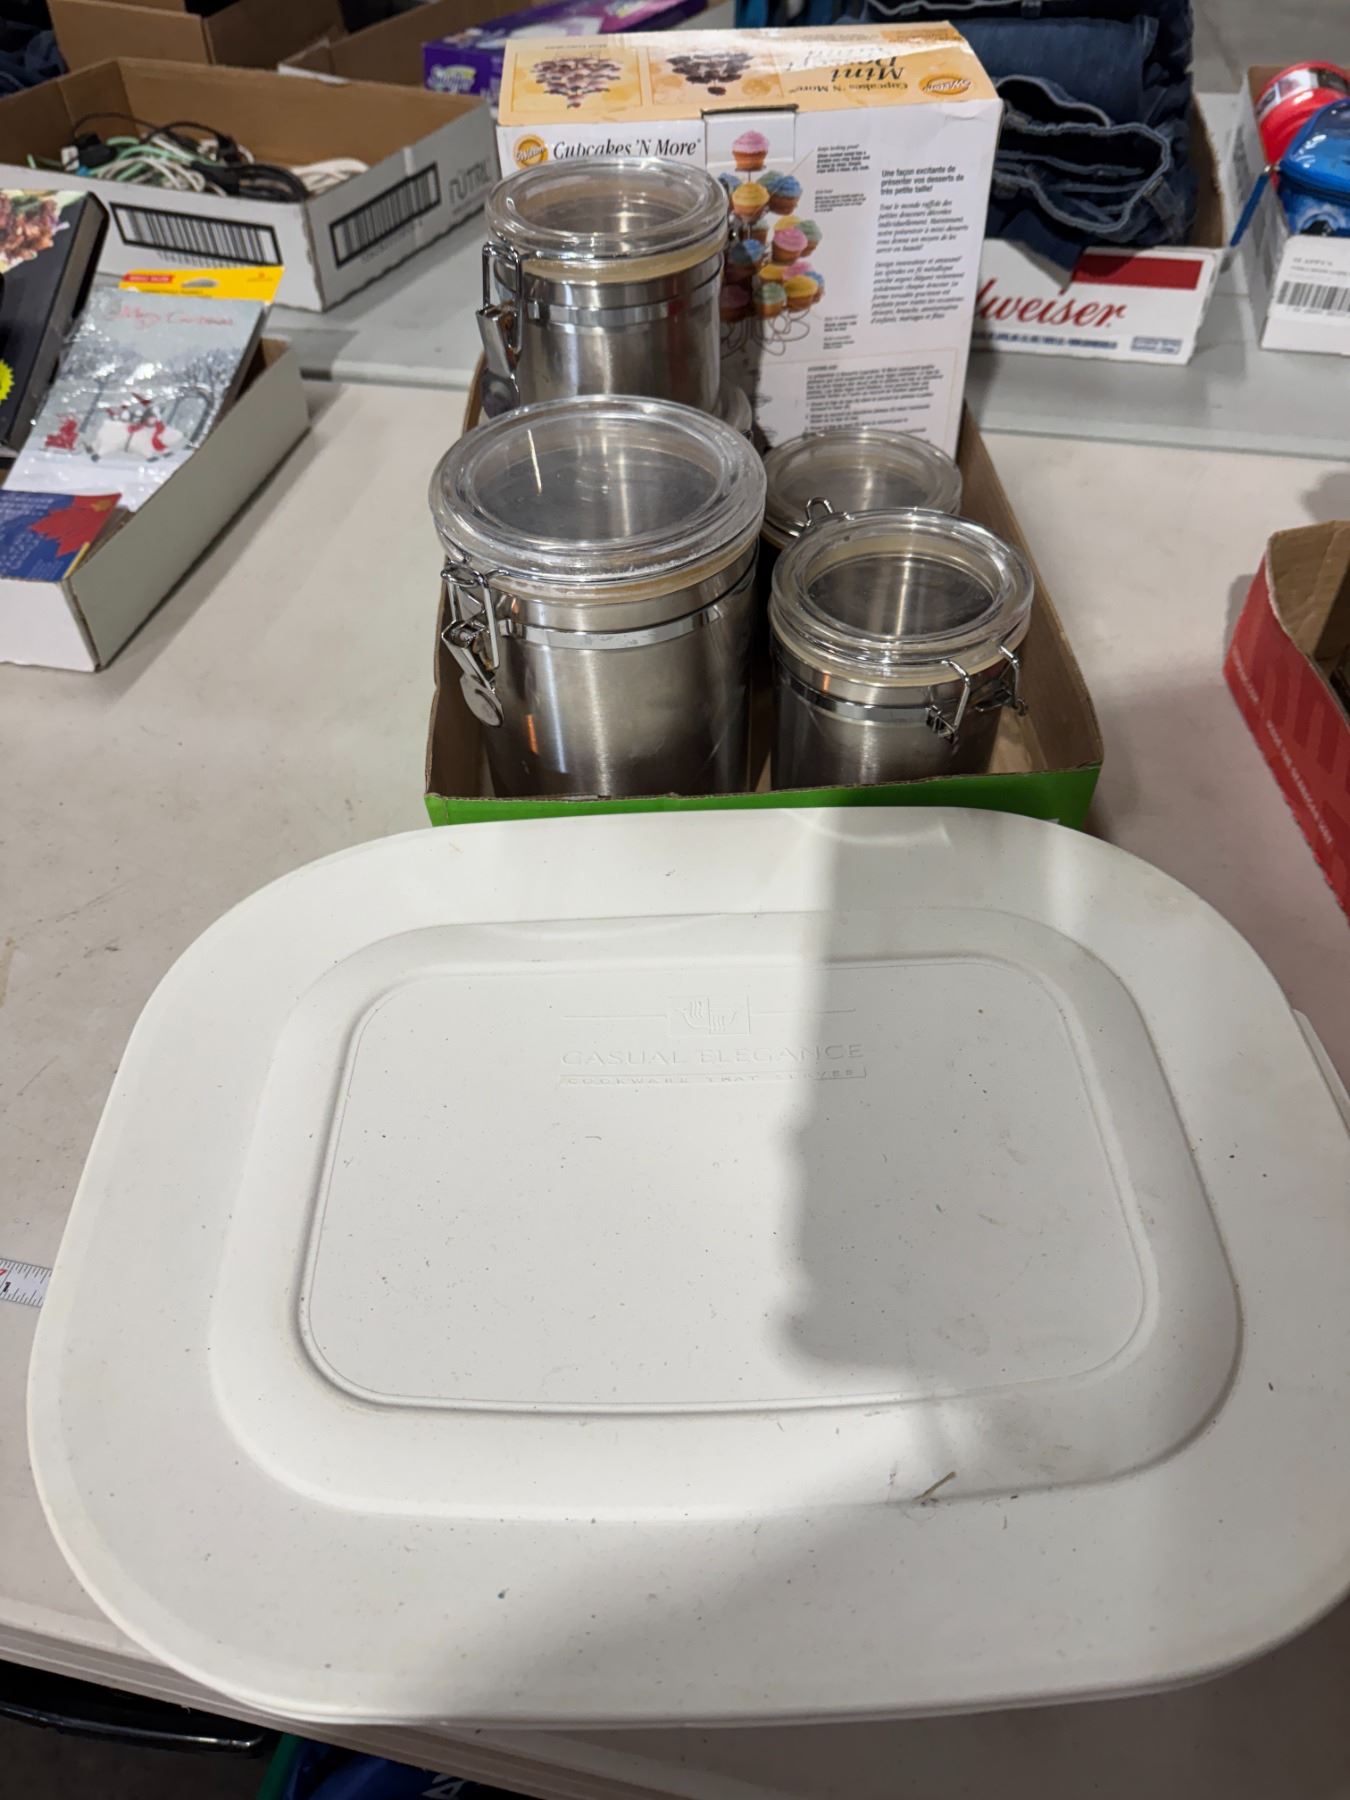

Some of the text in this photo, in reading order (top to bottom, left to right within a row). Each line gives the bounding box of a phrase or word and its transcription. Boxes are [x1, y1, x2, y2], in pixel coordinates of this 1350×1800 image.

[831, 67, 905, 82] Mini
[849, 82, 908, 92] Cupcakes
[896, 168, 914, 178] façon
[916, 167, 945, 175] excitante
[881, 178, 912, 187] présenter
[927, 175, 954, 183] desserts
[895, 186, 913, 195] petite
[561, 1043, 864, 1067] CASUAL ELEGANCE
